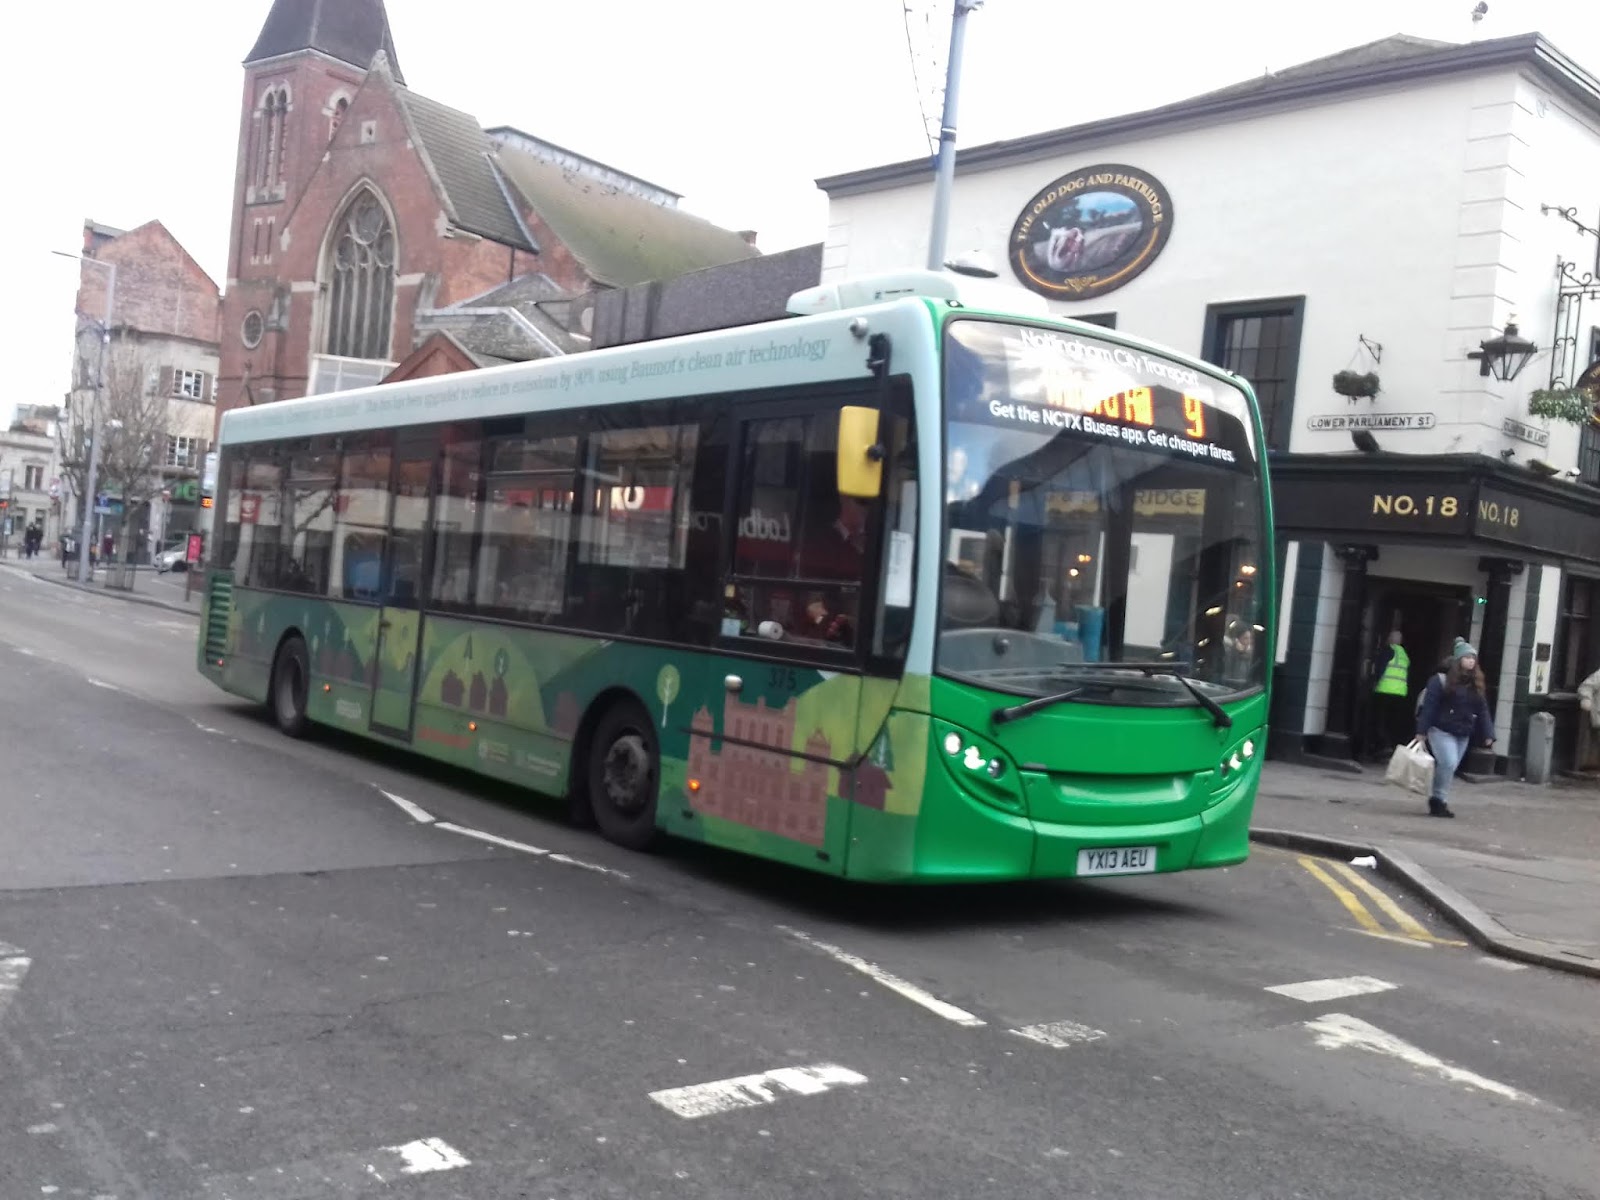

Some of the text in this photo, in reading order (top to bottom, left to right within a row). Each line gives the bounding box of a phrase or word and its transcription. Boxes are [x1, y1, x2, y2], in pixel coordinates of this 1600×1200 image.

[1033, 191, 1058, 215] OLD
[1057, 177, 1086, 198] DOG
[1087, 173, 1114, 187] AND
[1113, 174, 1164, 224] PARTRIDGE
[560, 370, 571, 391] by
[598, 364, 628, 384] using
[630, 357, 685, 378] Baumot's
[687, 350, 722, 372] clean
[725, 345, 746, 367] air
[749, 337, 831, 364] technology
[1019, 329, 1200, 387] Nottingham City Transport
[989, 400, 1236, 463] Get the NCTX Buses app. Get cheaper fares.
[1311, 416, 1431, 428] LOWER PARLIAMENT ST
[1086, 848, 1149, 870] YX13 AEU
